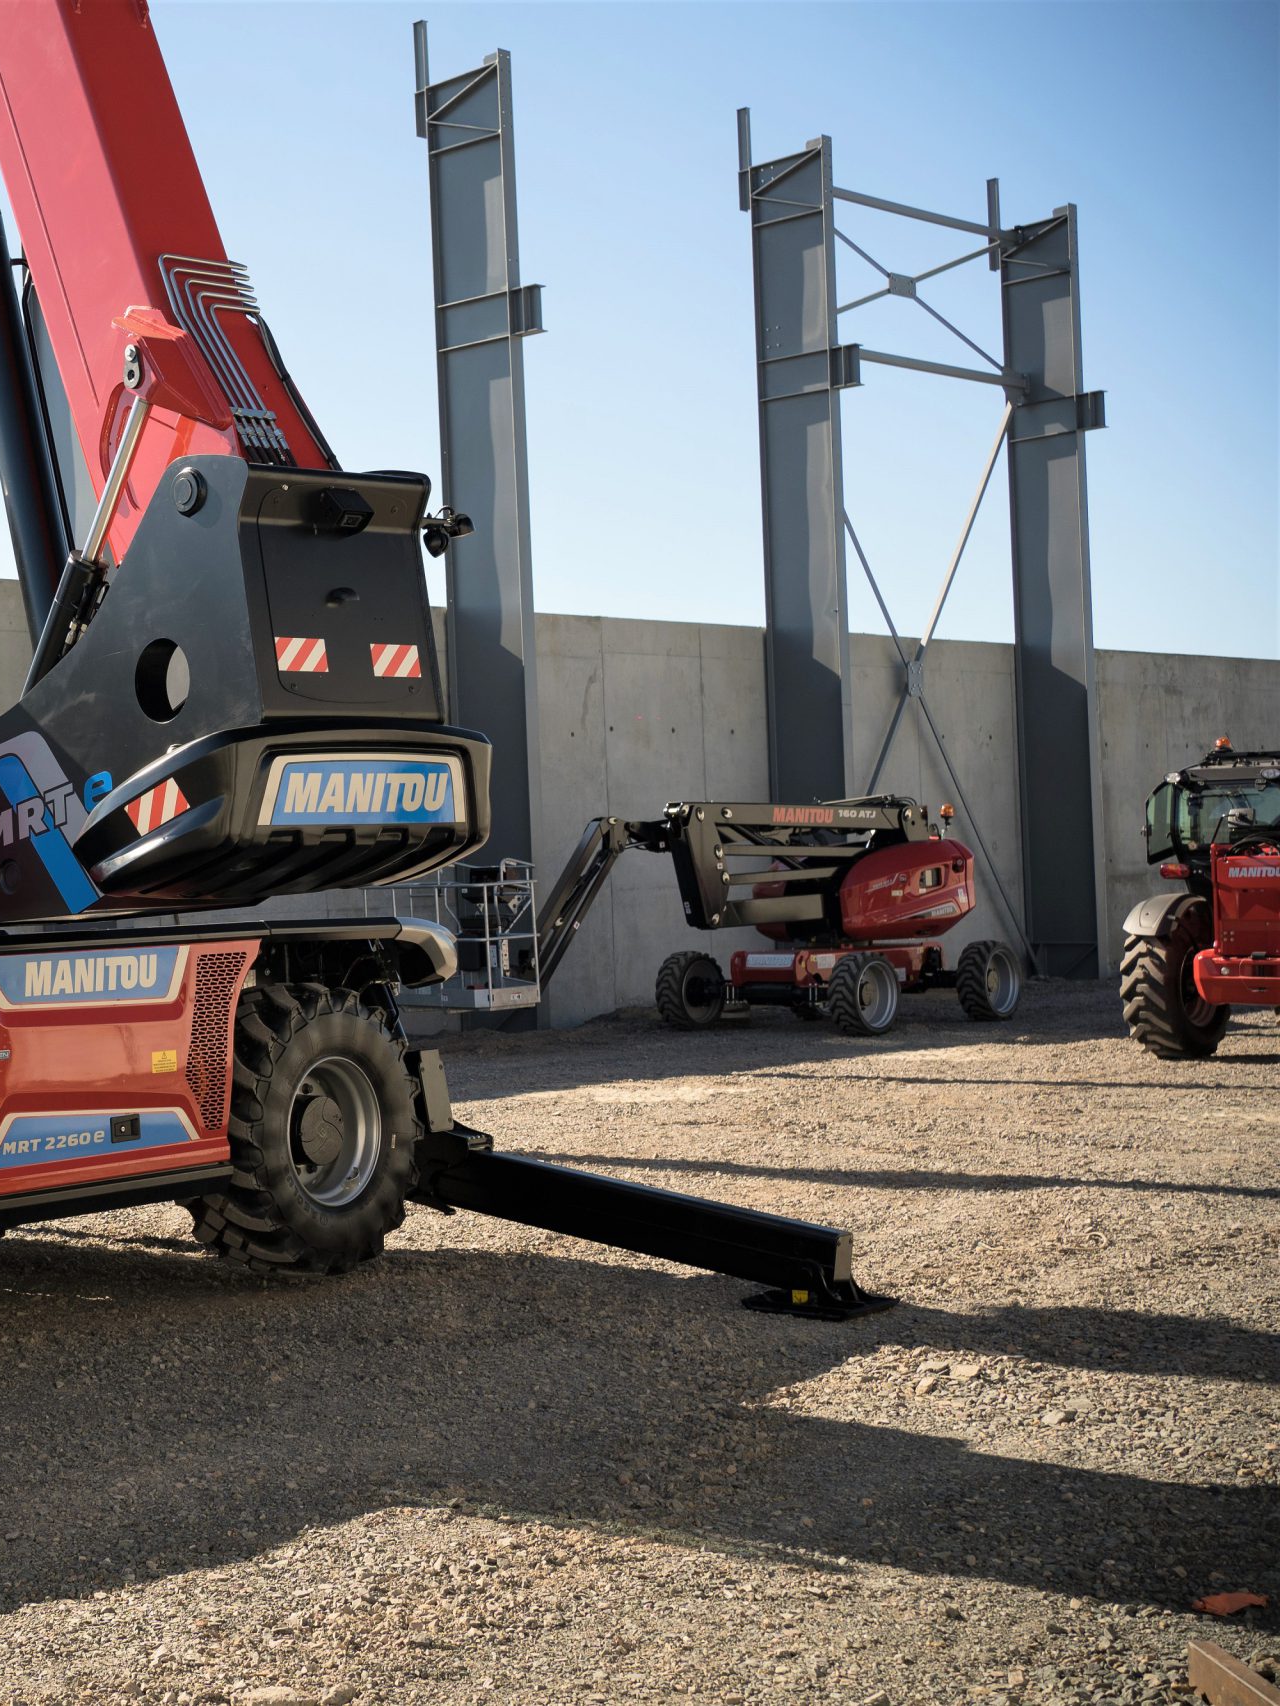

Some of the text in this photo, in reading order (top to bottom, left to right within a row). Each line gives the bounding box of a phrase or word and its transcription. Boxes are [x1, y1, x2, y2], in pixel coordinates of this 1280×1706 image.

[83, 770, 113, 814] e
[283, 772, 449, 813] MANITOU
[772, 807, 876, 824] MANITOU 160 ATJ
[24, 953, 158, 998] MANITOU
[2, 1130, 105, 1156] MRT 2260 e
